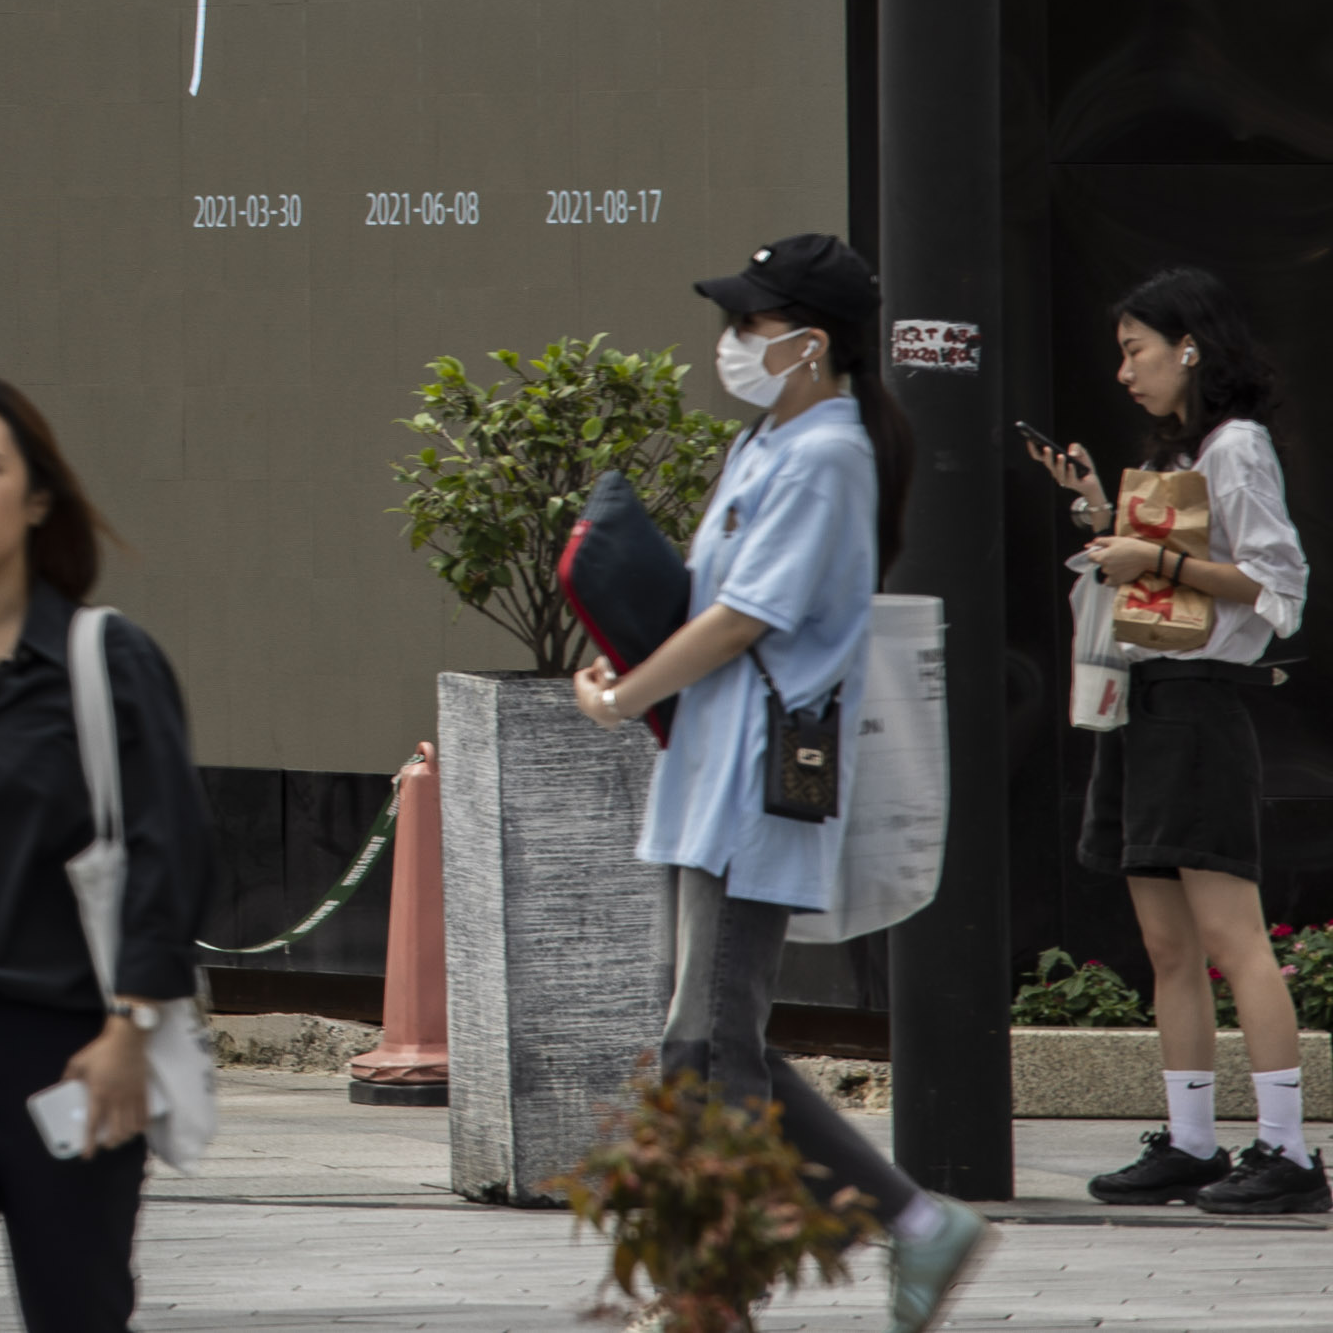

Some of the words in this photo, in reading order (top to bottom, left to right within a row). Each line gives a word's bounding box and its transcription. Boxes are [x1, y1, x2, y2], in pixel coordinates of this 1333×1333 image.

[192, 193, 302, 229] 2021-03-30
[364, 190, 480, 226] 2021-06-08
[544, 188, 663, 225] 2021-08-17
